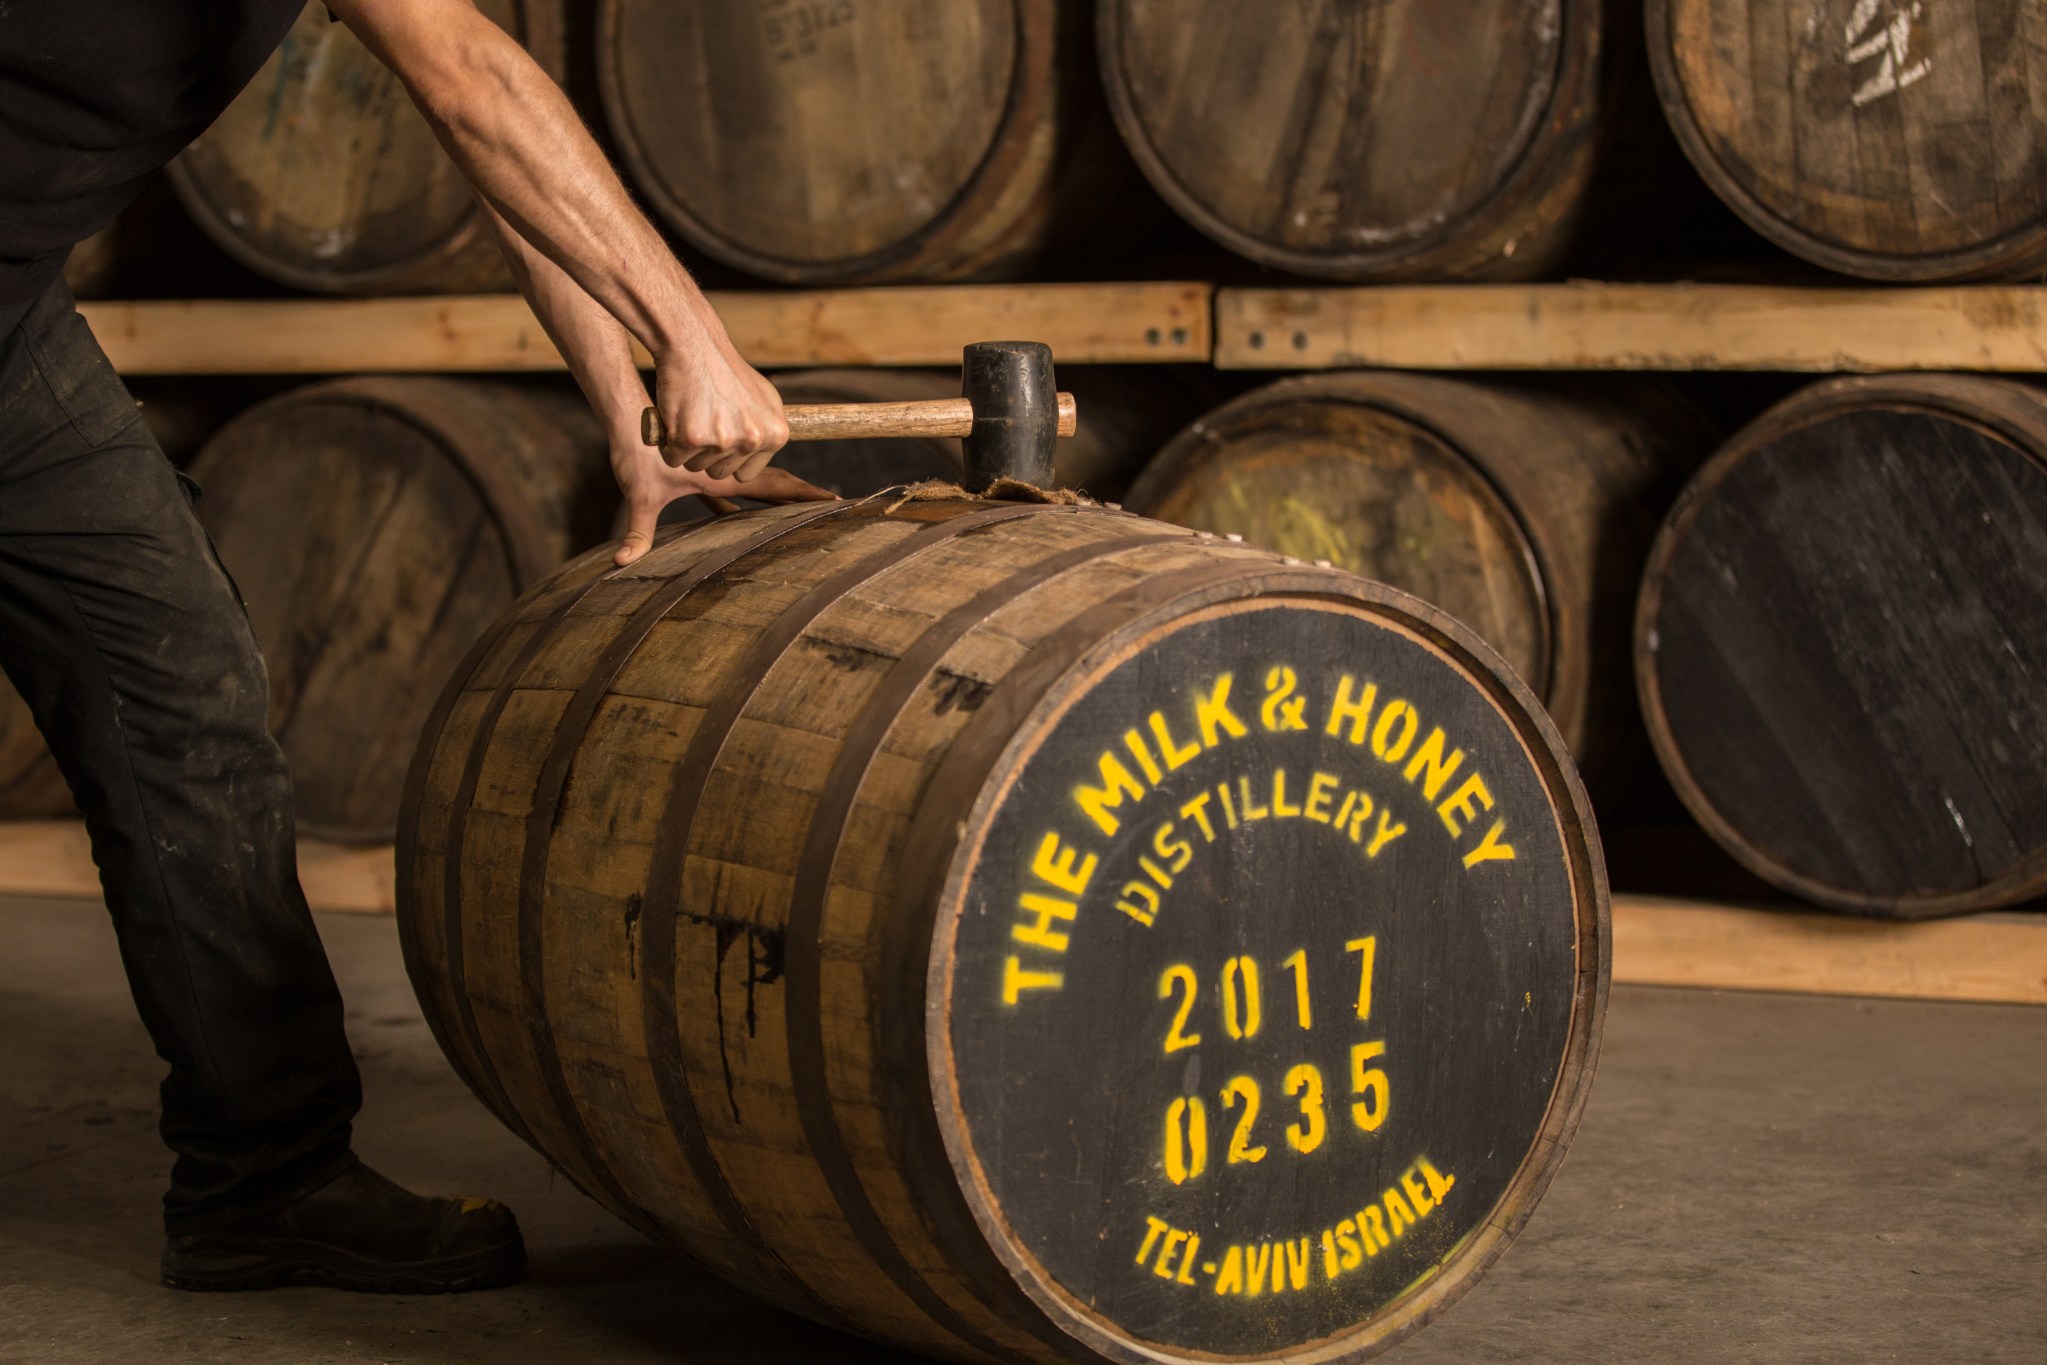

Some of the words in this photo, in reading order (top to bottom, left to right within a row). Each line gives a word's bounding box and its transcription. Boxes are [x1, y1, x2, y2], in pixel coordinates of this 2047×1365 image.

[1001, 830, 1099, 1007] THE
[1073, 673, 1248, 838] MILK
[1259, 667, 1309, 732] &
[1324, 676, 1516, 869] HONEY
[1115, 768, 1407, 928] DISTILLERY
[1158, 935, 1377, 1055] 2017
[1162, 1040, 1390, 1185] 0235
[1135, 1215, 1312, 1299] TEL-AVIV
[1321, 1157, 1456, 1282] ISRAEL
